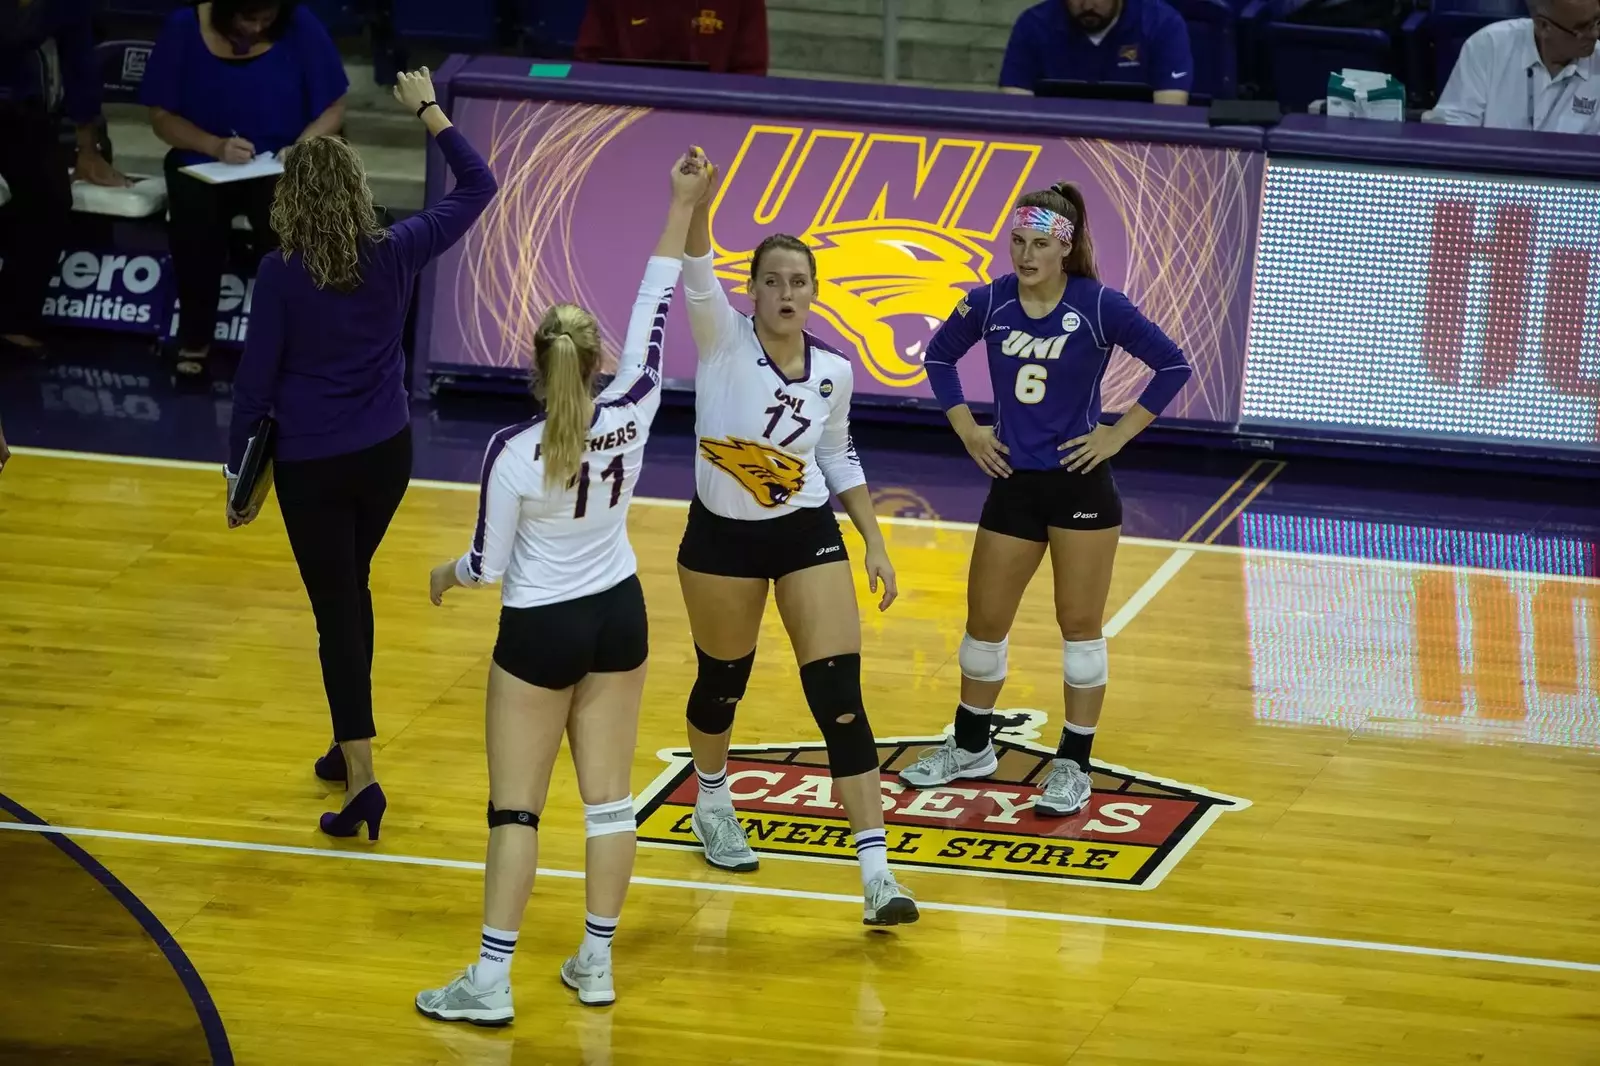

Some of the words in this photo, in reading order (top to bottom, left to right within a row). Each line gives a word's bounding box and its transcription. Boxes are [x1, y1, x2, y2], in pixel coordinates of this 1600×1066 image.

[708, 125, 1042, 257] UNI
[42, 294, 151, 323] atalities
[1002, 330, 1072, 360] UNI
[1015, 364, 1048, 404] 6
[762, 404, 811, 448] 17
[727, 770, 1152, 834] CAEYS
[669, 813, 922, 855] NERL
[937, 837, 1119, 870] STORE
